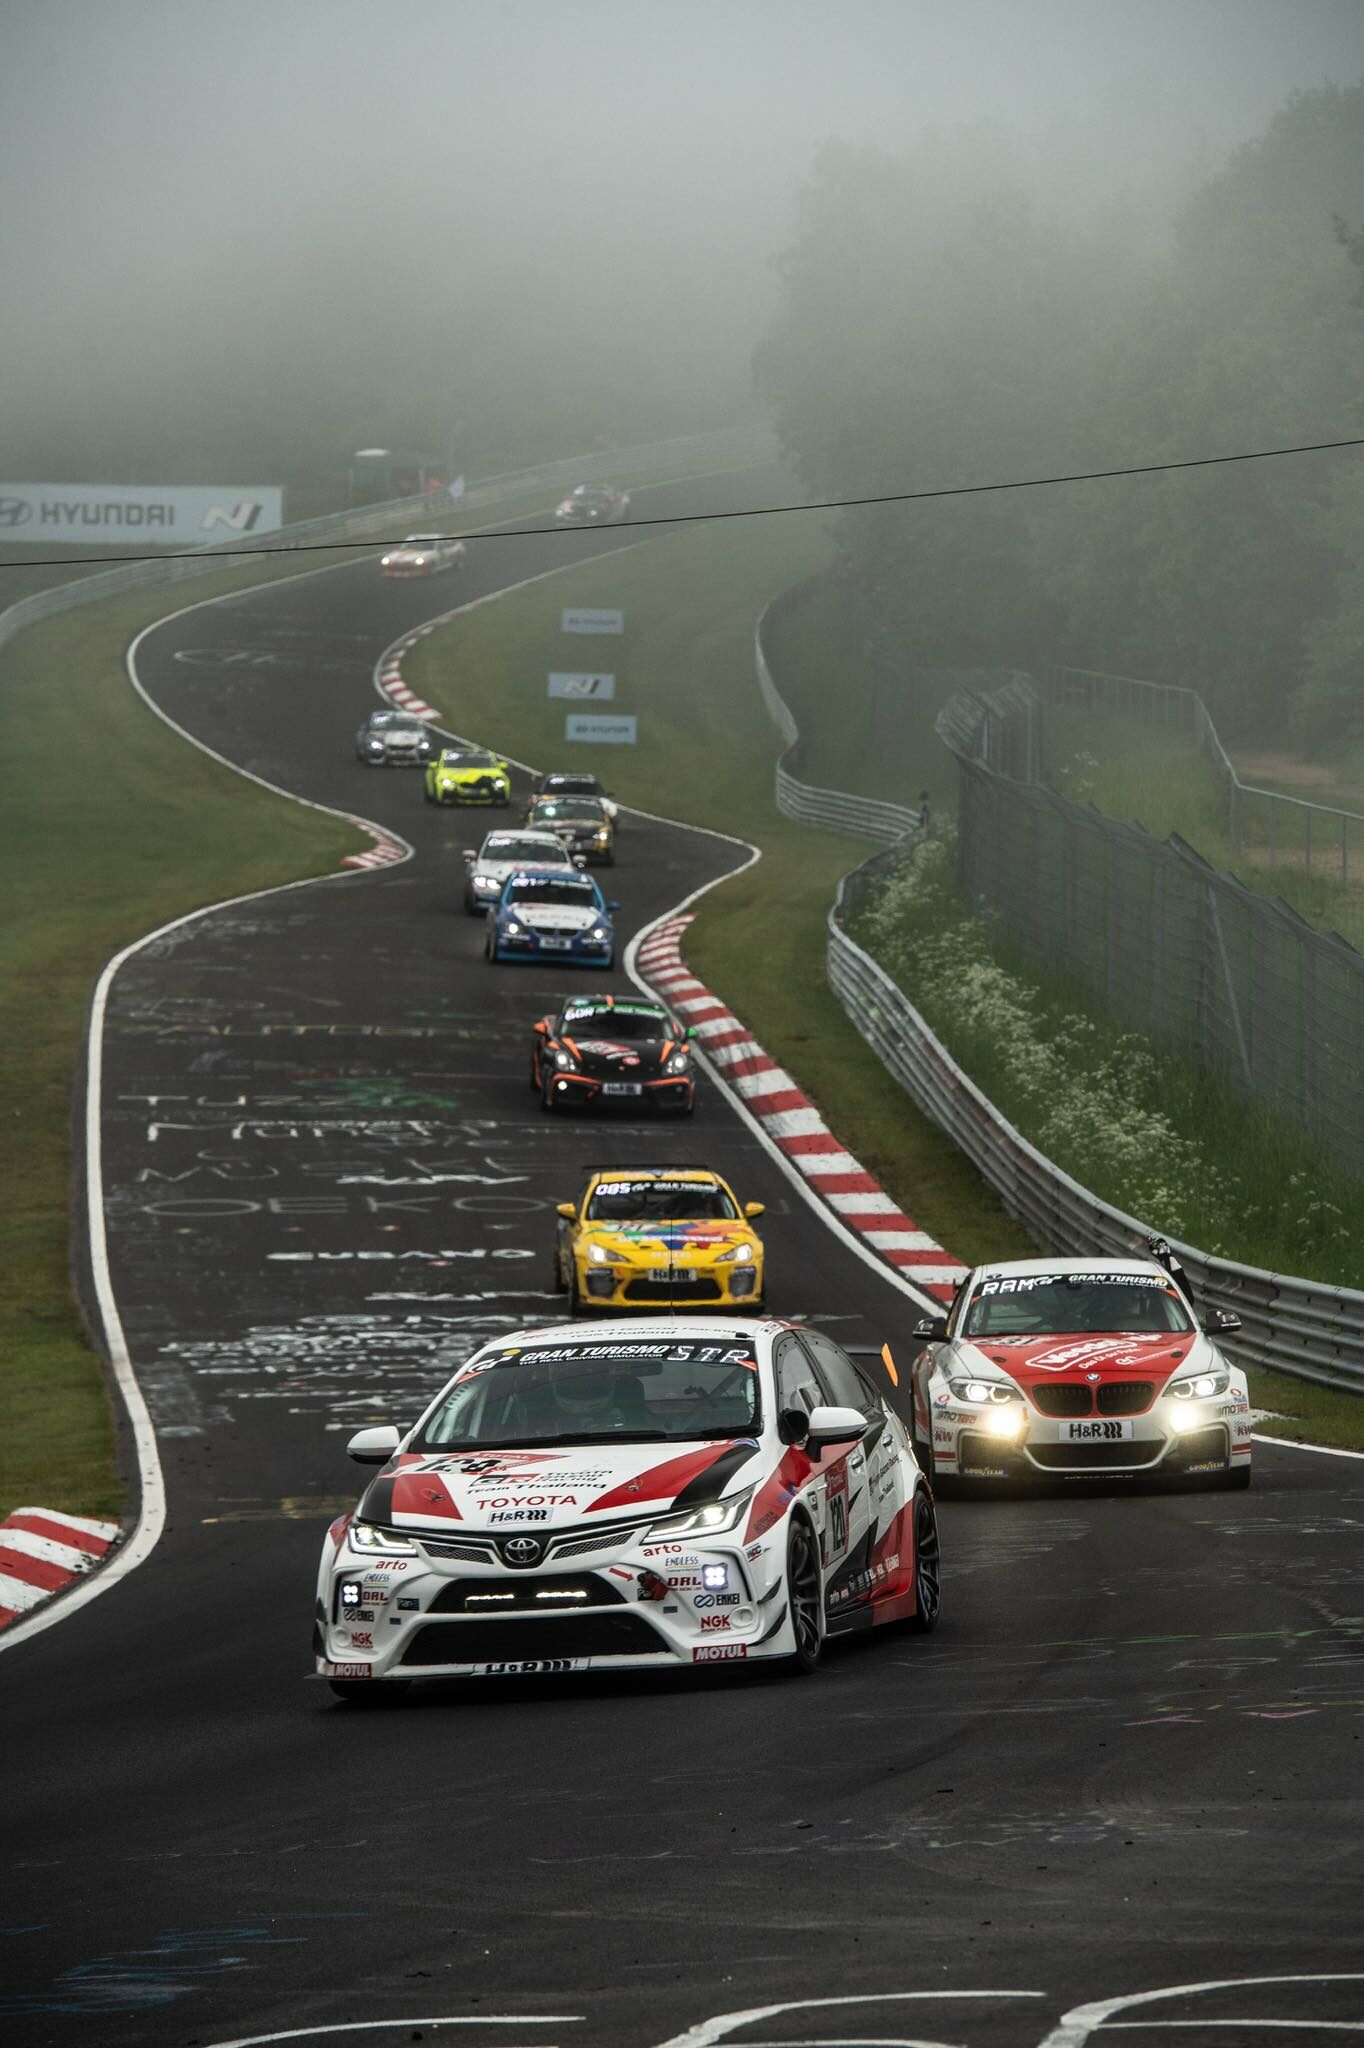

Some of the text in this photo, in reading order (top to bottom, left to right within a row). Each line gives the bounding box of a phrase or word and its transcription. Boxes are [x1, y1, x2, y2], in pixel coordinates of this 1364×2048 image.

[41, 504, 175, 525] HYUNDAI
[981, 1278, 1035, 1297] RAM
[1069, 1274, 1106, 1283] GRAN
[1110, 1275, 1169, 1288] TURISMO
[519, 1348, 579, 1362] GRAN
[580, 1345, 670, 1356] TURISMO
[667, 1346, 750, 1363] STR
[1069, 1423, 1102, 1439] H&R
[476, 1495, 578, 1511] TOYOTA
[490, 1510, 526, 1523] H&R
[643, 1544, 682, 1557] arto
[376, 1560, 408, 1571] arto
[665, 1556, 699, 1567] ENDLESS
[716, 1592, 741, 1606] ENKEI
[701, 1614, 731, 1629] NGK
[352, 1632, 374, 1646] NGK
[695, 1645, 745, 1661] MOTUL
[335, 1663, 371, 1677] MOTUL
